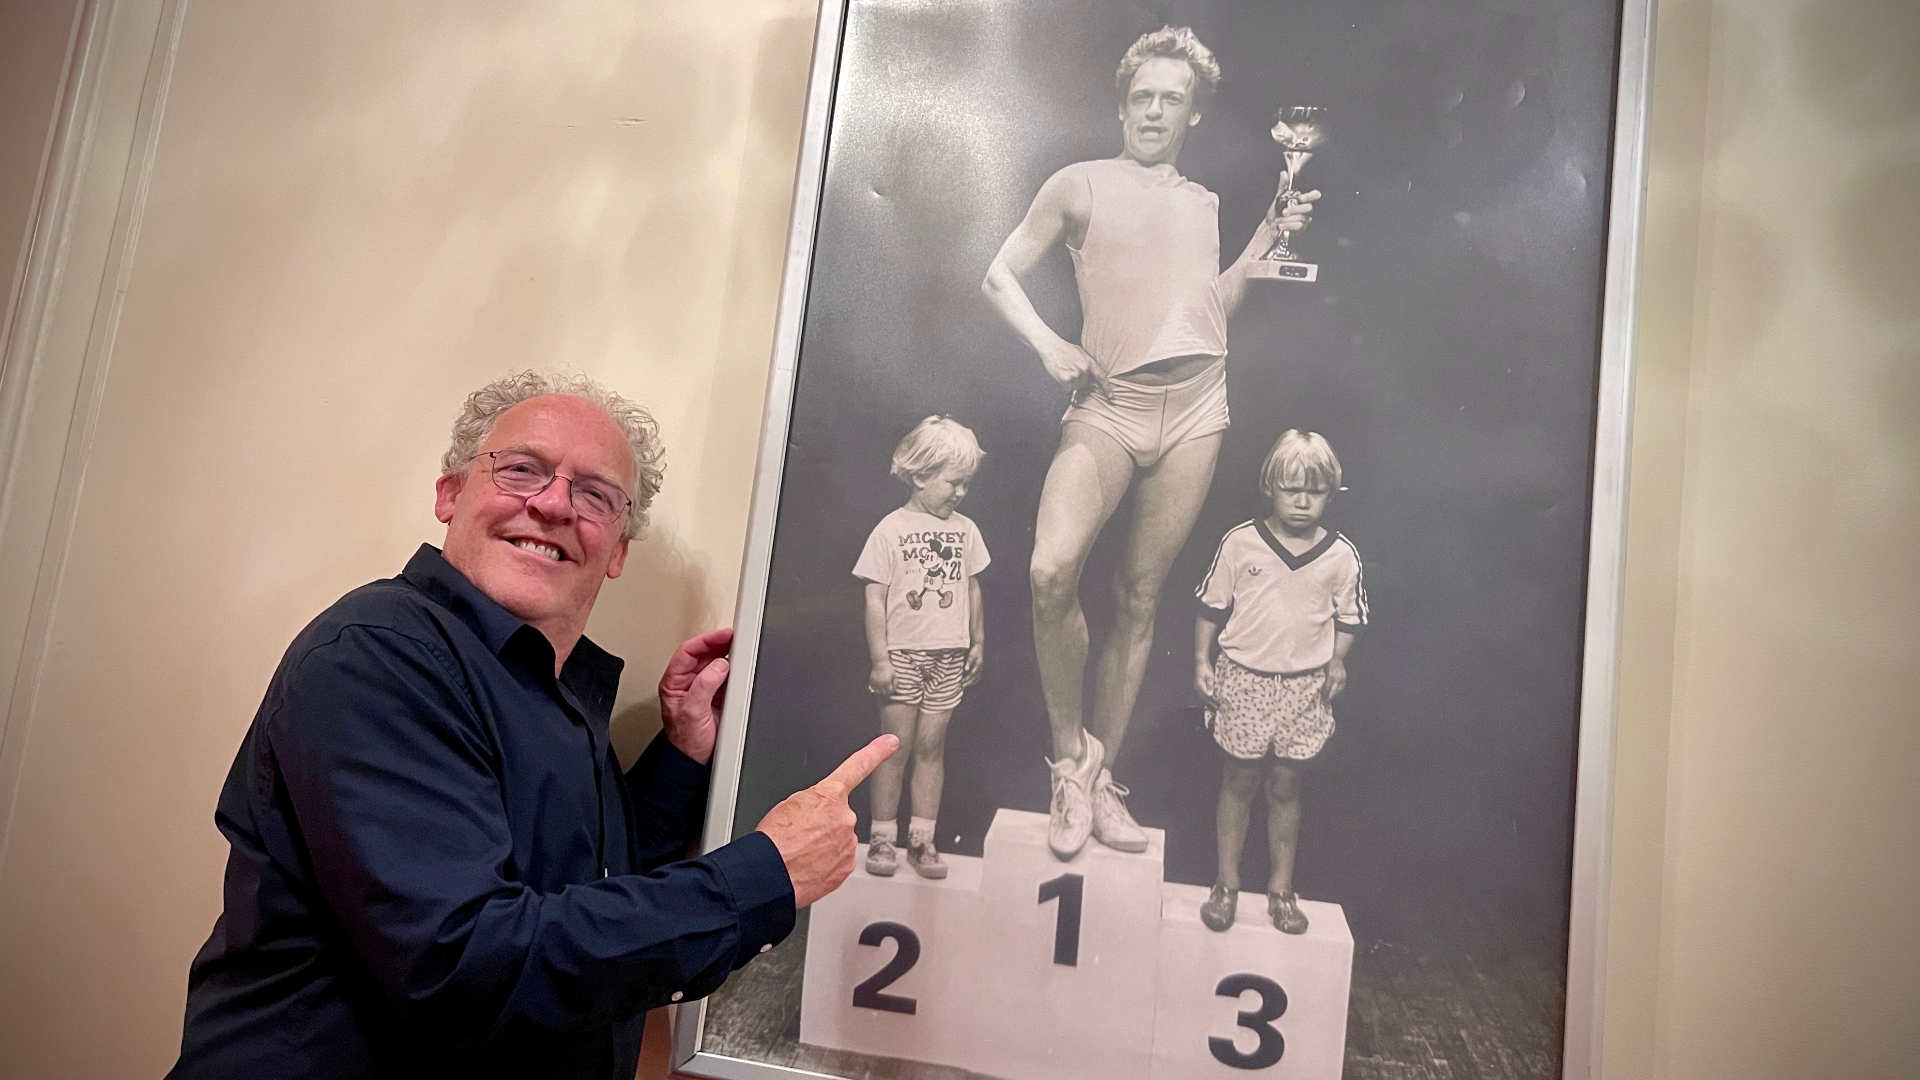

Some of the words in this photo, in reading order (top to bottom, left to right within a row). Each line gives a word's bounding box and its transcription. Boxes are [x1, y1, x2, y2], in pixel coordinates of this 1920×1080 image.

[898, 531, 965, 546] MICKEY
[902, 546, 962, 561] MOE
[1038, 873, 1084, 967] 1
[852, 921, 921, 1015] 2
[1208, 973, 1288, 1070] 3
